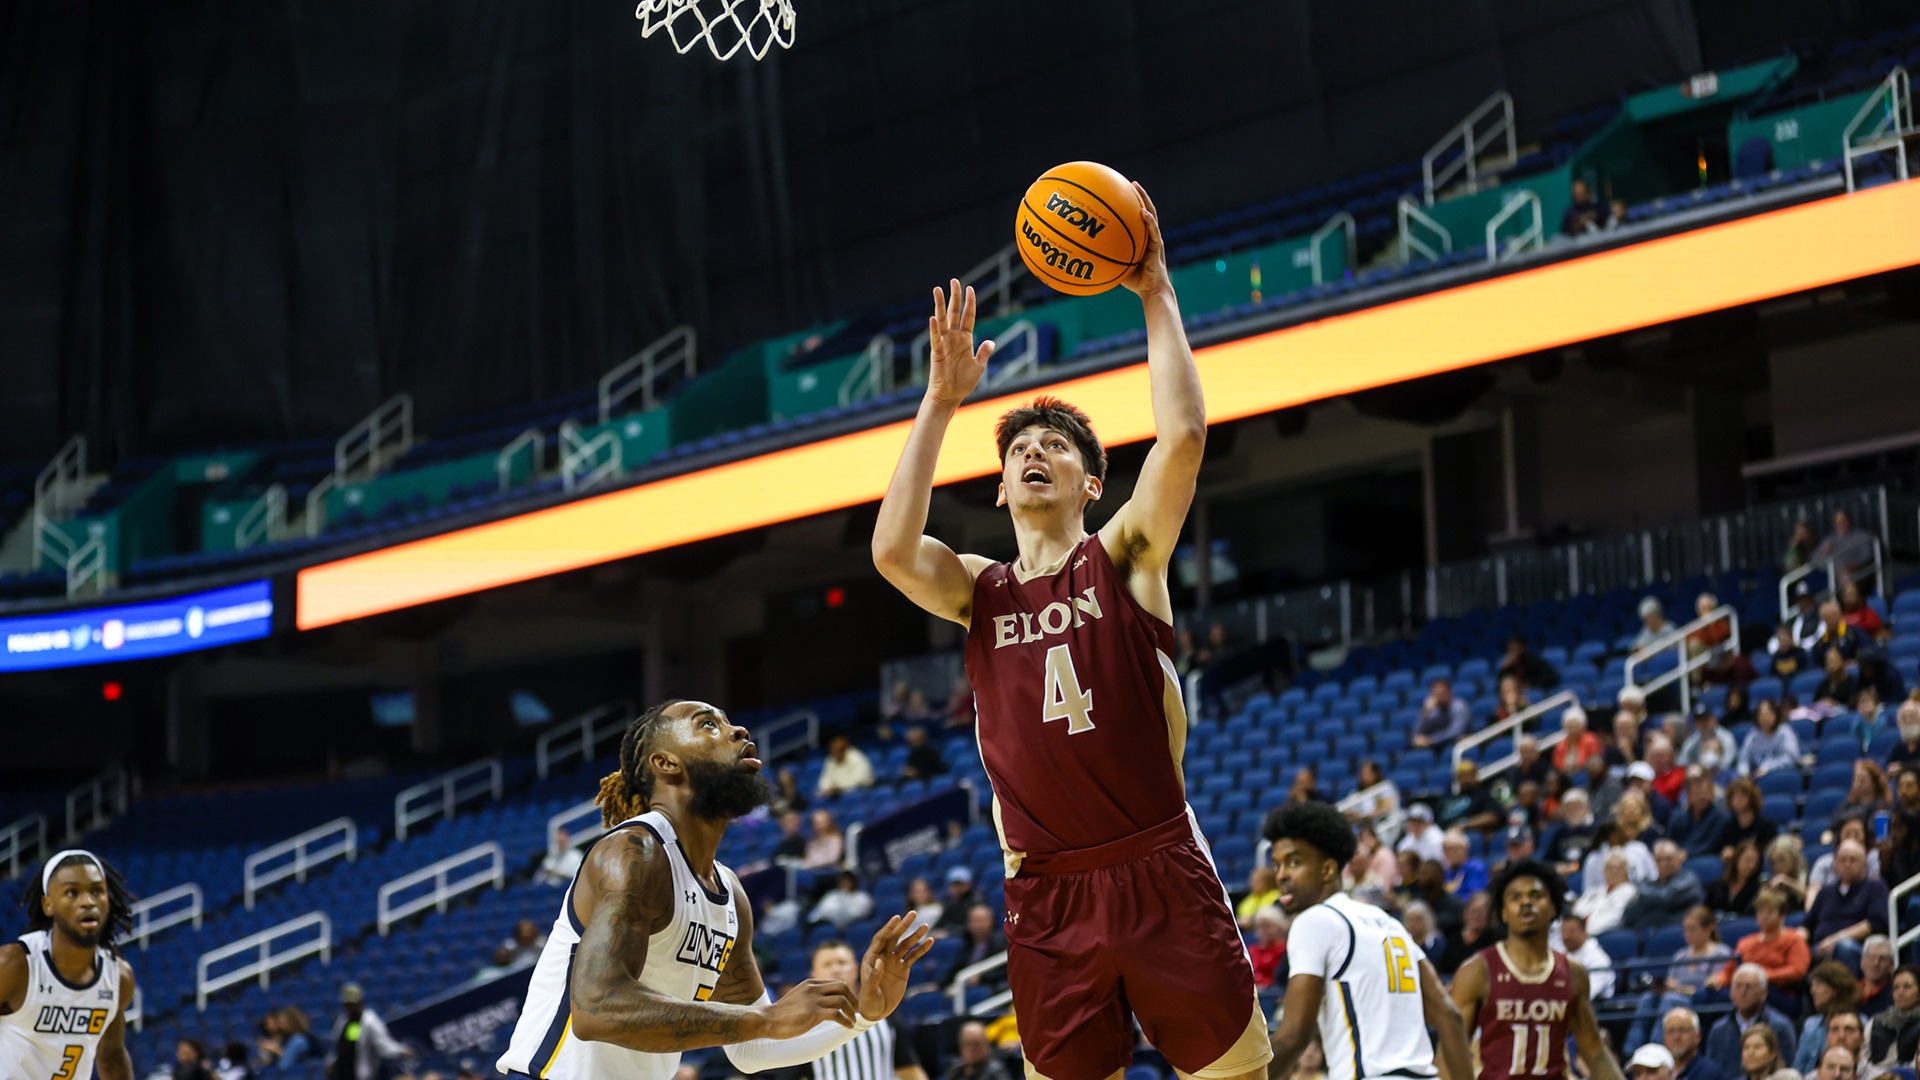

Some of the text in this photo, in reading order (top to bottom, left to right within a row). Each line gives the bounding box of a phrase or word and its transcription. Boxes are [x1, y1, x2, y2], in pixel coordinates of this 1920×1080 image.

[1046, 192, 1106, 239] NCAA
[1022, 219, 1095, 281] Wilson
[993, 586, 1103, 649] ELON
[1043, 643, 1096, 735] 4
[1383, 937, 1417, 993] 12
[34, 1005, 108, 1035] UNCG
[1496, 999, 1568, 1022] ELON
[51, 1044, 84, 1080] 3
[1509, 1024, 1551, 1076] 11
